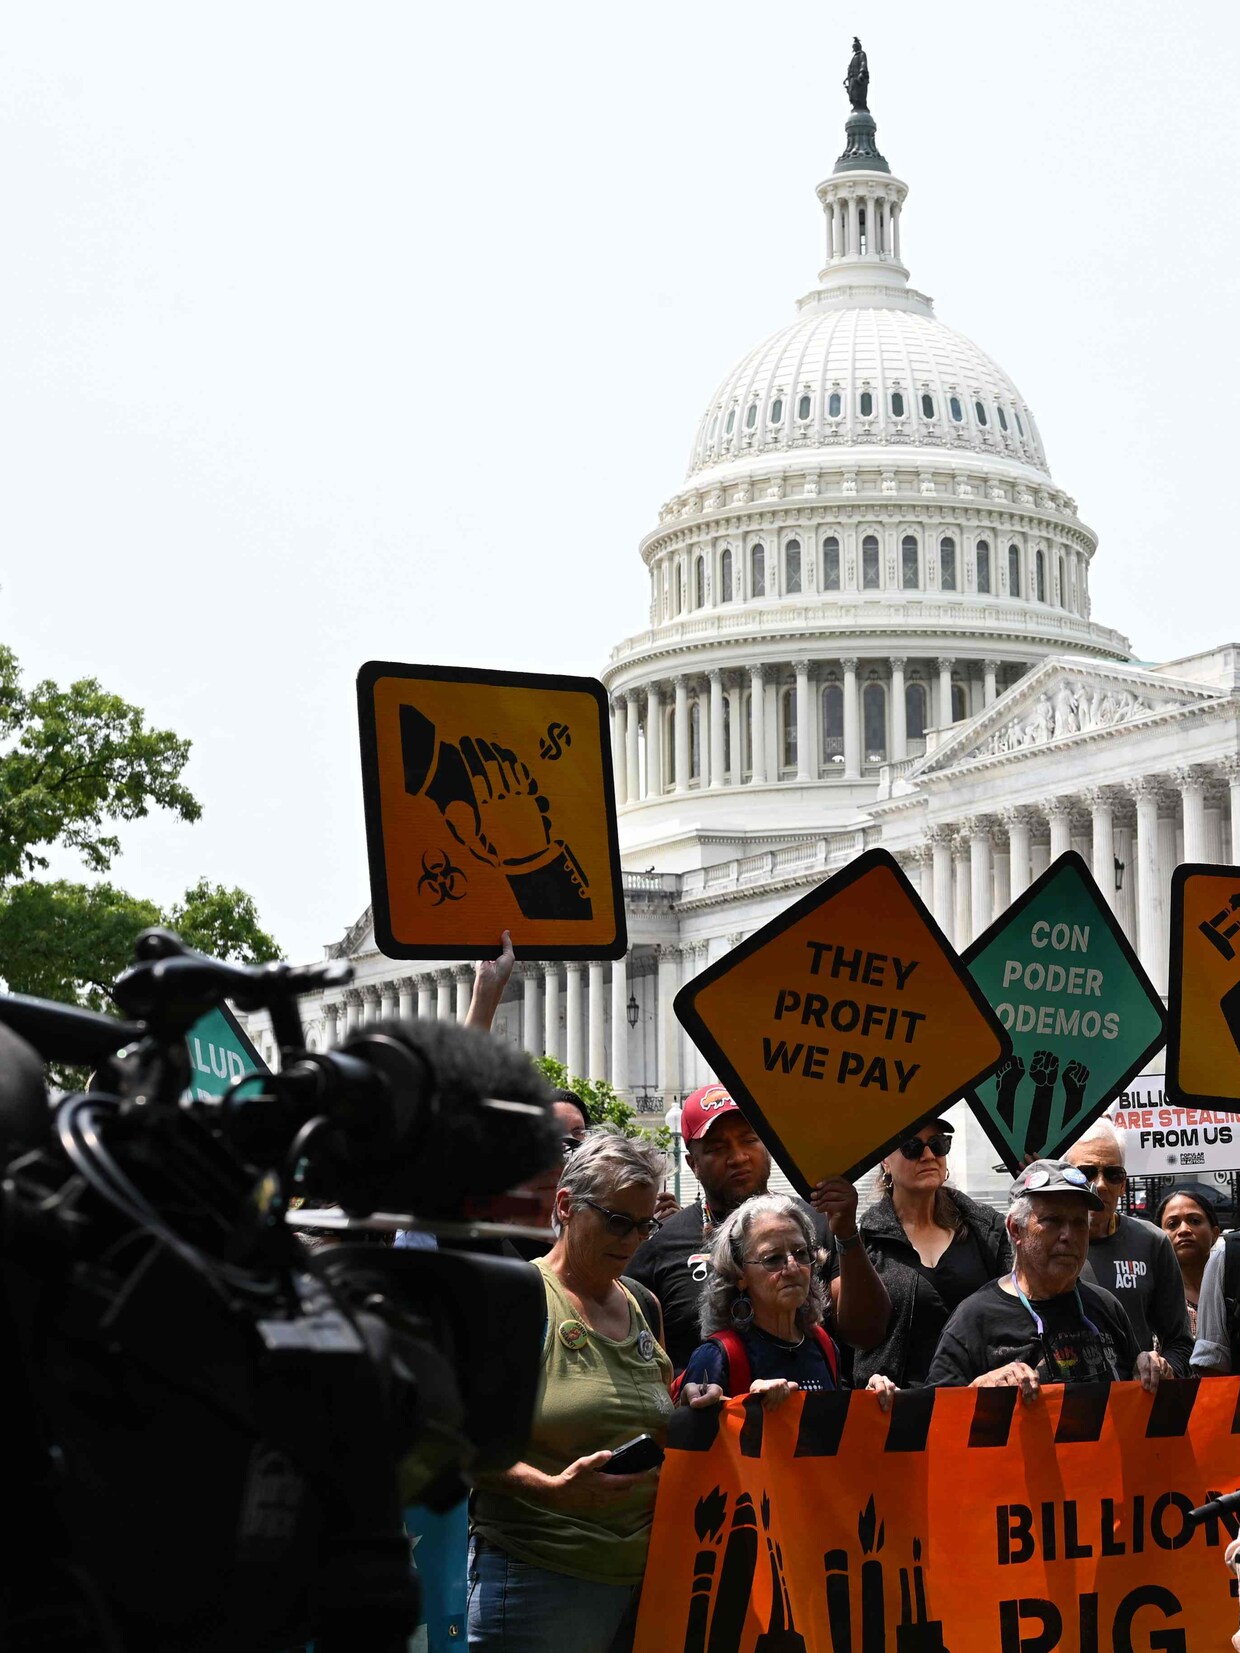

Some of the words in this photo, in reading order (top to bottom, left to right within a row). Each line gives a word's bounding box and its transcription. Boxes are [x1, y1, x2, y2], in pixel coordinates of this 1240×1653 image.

[1031, 920, 1090, 953] CON
[806, 940, 921, 991] THEY
[1002, 960, 1104, 997] PODER
[773, 989, 927, 1044] PROFIT
[995, 1002, 1120, 1040] ODEMOS
[185, 1035, 246, 1083] LUD
[762, 1037, 830, 1080] WE
[837, 1051, 922, 1094] PAY
[1114, 1110, 1154, 1130] ARE
[1140, 1128, 1199, 1149] FROM
[1203, 1126, 1233, 1145] US
[1115, 1273, 1137, 1289] ACT
